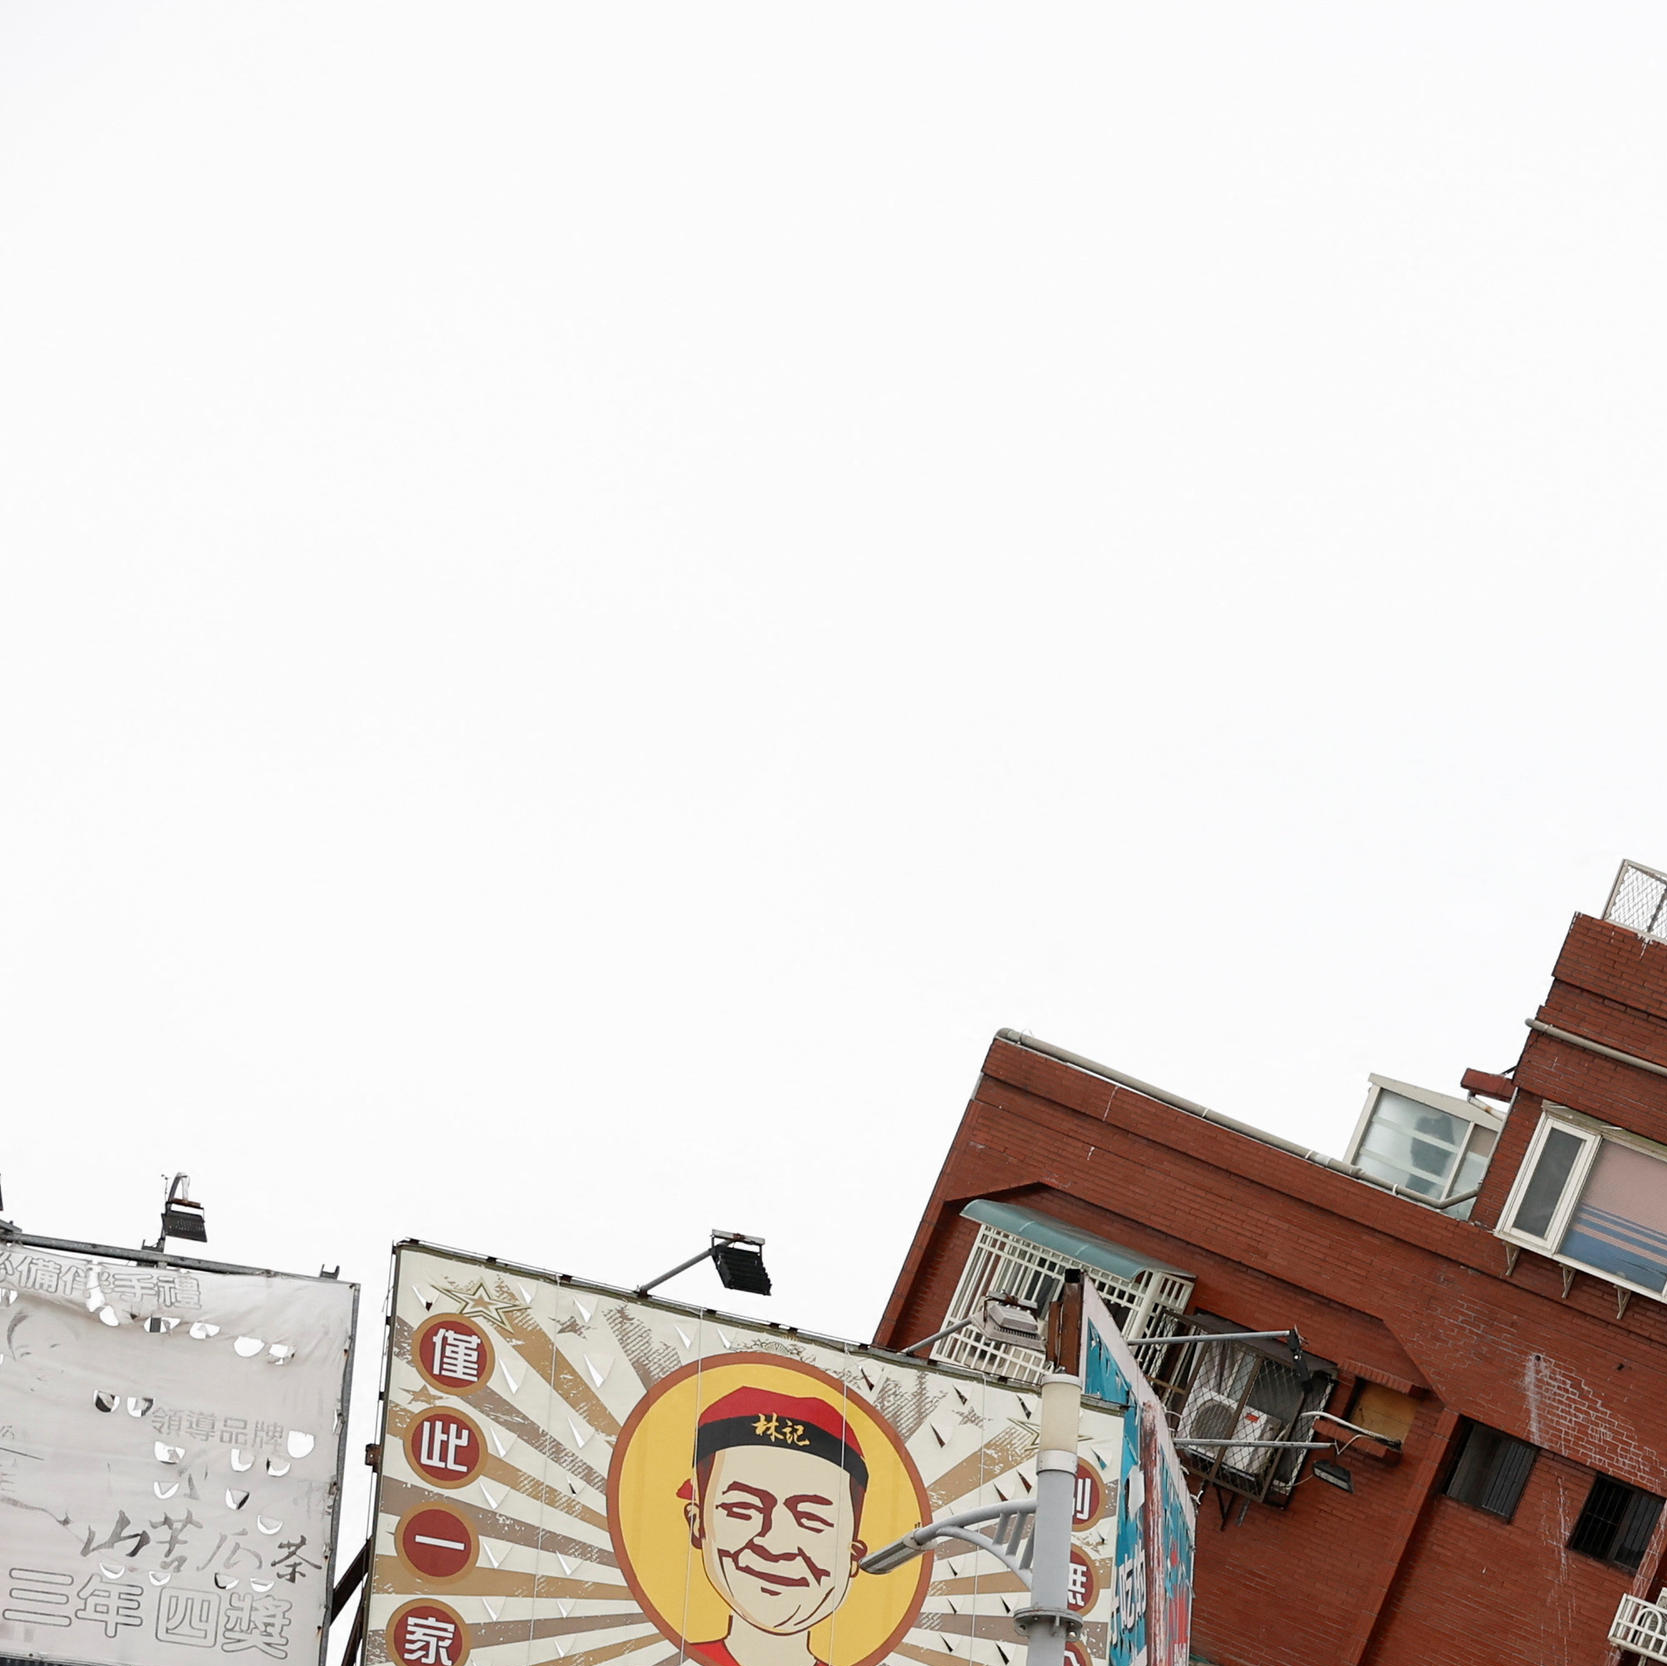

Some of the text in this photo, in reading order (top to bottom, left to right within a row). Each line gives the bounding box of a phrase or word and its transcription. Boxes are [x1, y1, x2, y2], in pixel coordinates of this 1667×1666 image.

[751, 1411, 811, 1447] 林記
[2, 1567, 294, 1660] 三年四獎
